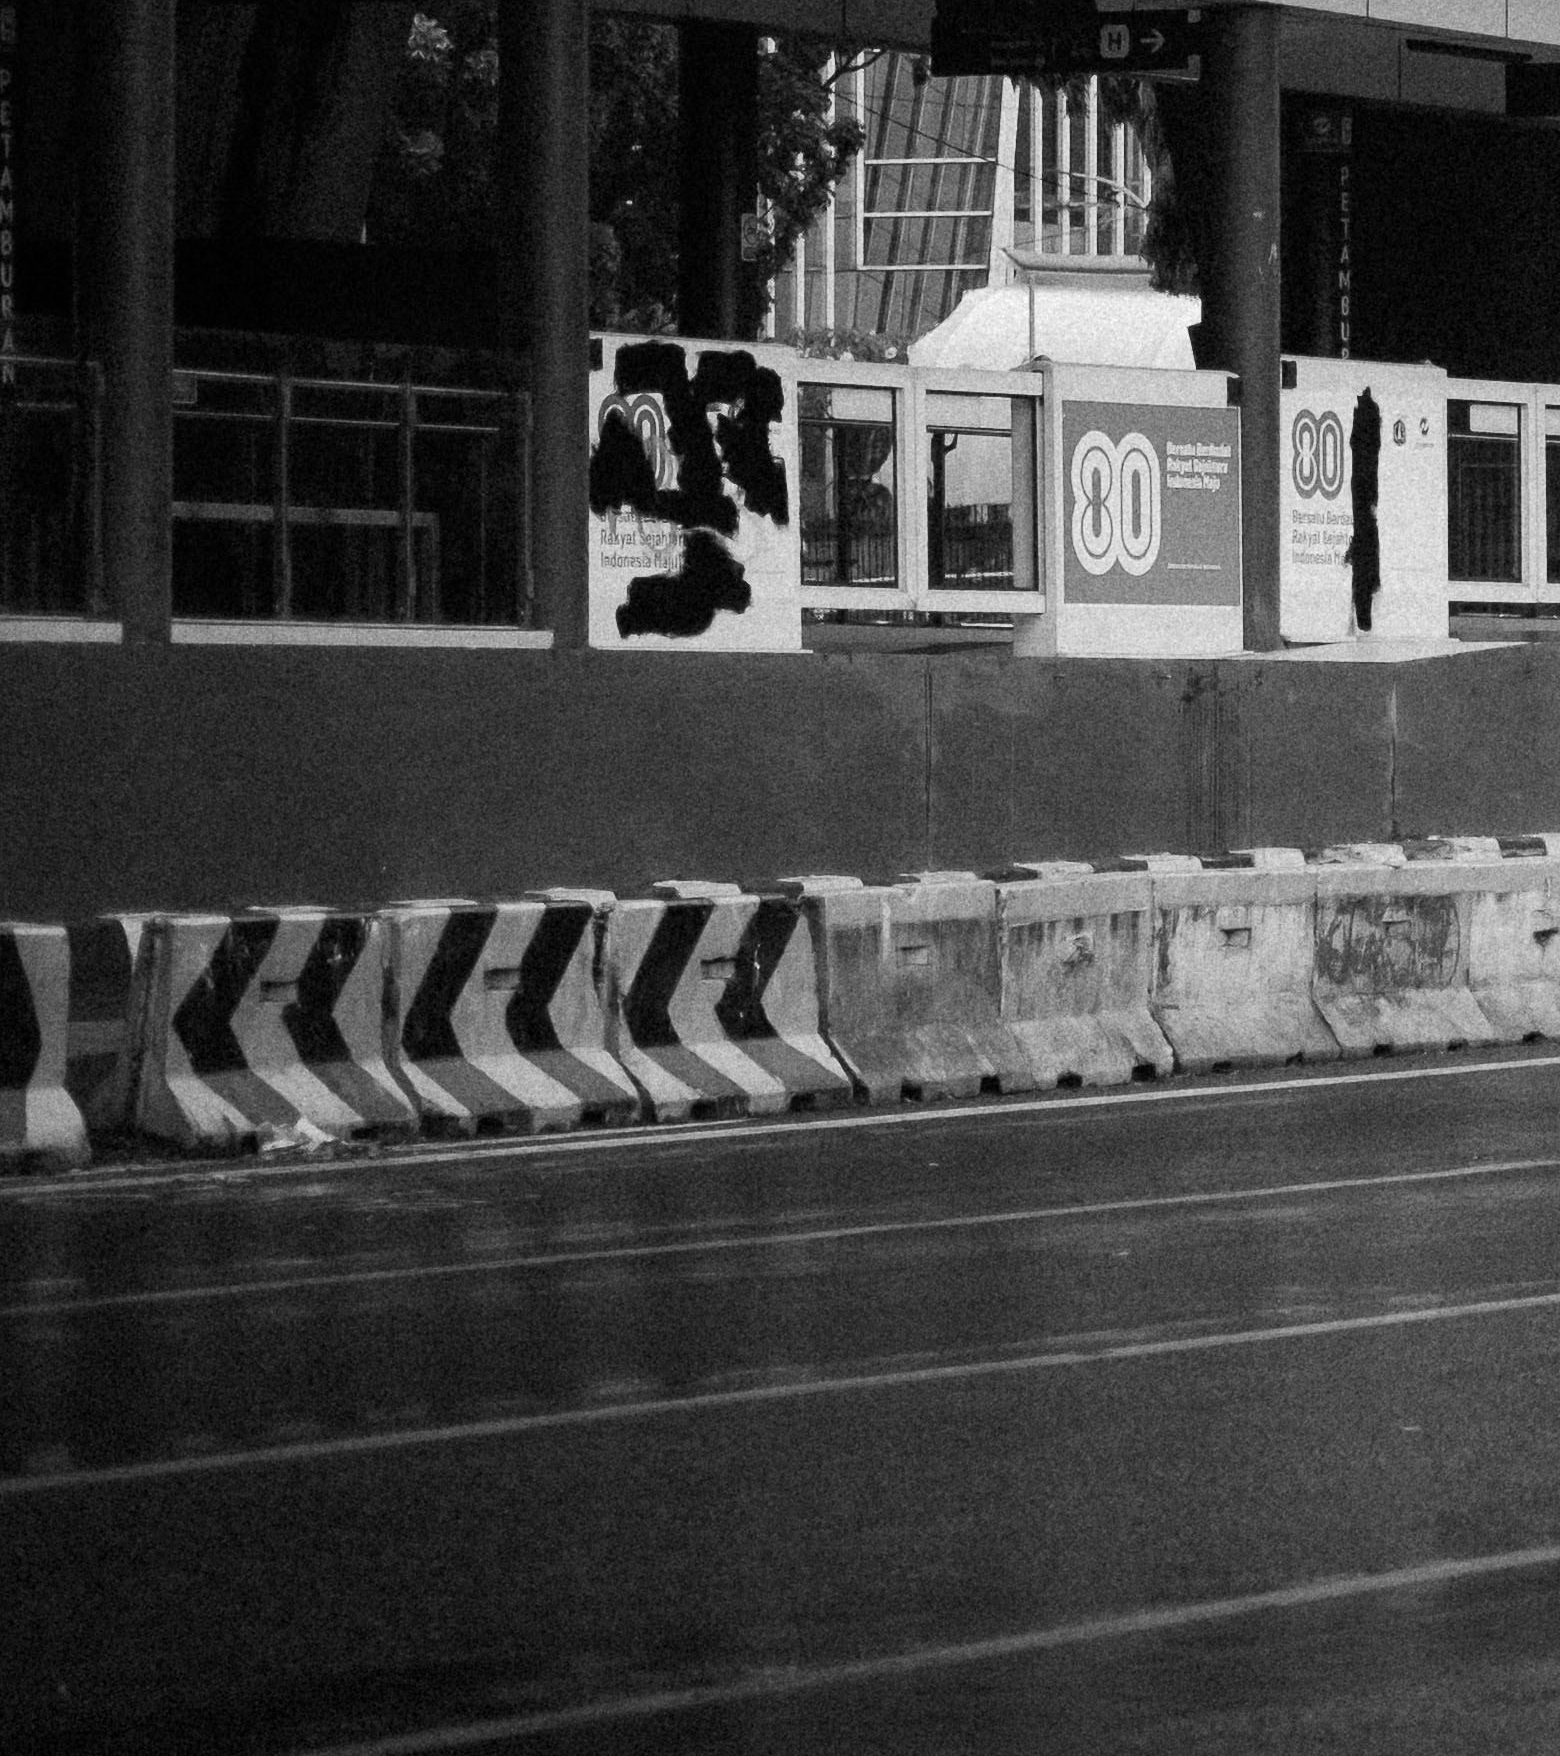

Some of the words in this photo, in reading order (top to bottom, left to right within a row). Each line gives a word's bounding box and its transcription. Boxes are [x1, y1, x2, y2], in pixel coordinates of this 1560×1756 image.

[1107, 33, 1122, 51] H
[1292, 408, 1345, 501] 80
[1071, 429, 1161, 576] 80
[600, 529, 636, 549] Rakyat
[600, 551, 651, 569] Indonesia
